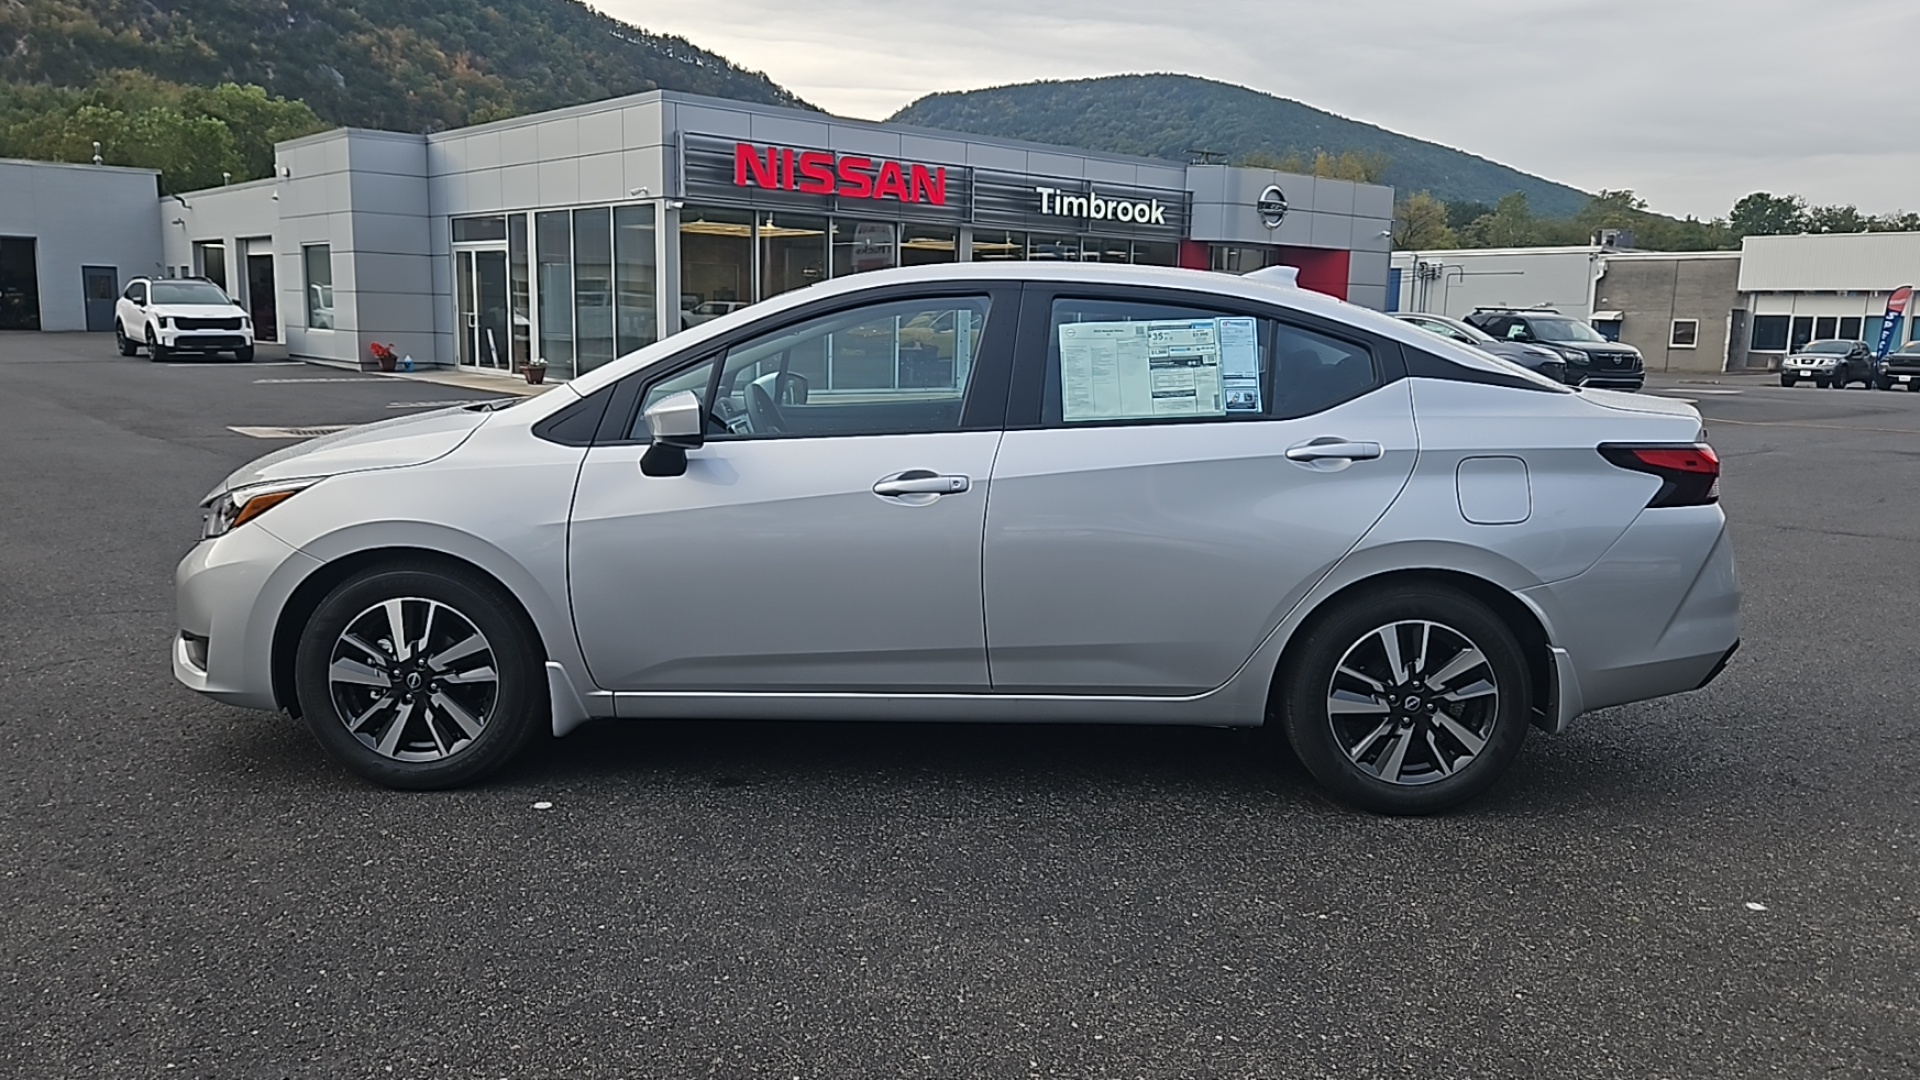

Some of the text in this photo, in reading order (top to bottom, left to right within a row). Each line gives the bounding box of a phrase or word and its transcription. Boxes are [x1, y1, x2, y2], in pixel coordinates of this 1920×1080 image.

[735, 142, 945, 205] NISSAN
[1036, 186, 1165, 224] Timbrook
[1152, 332, 1164, 341] 35
